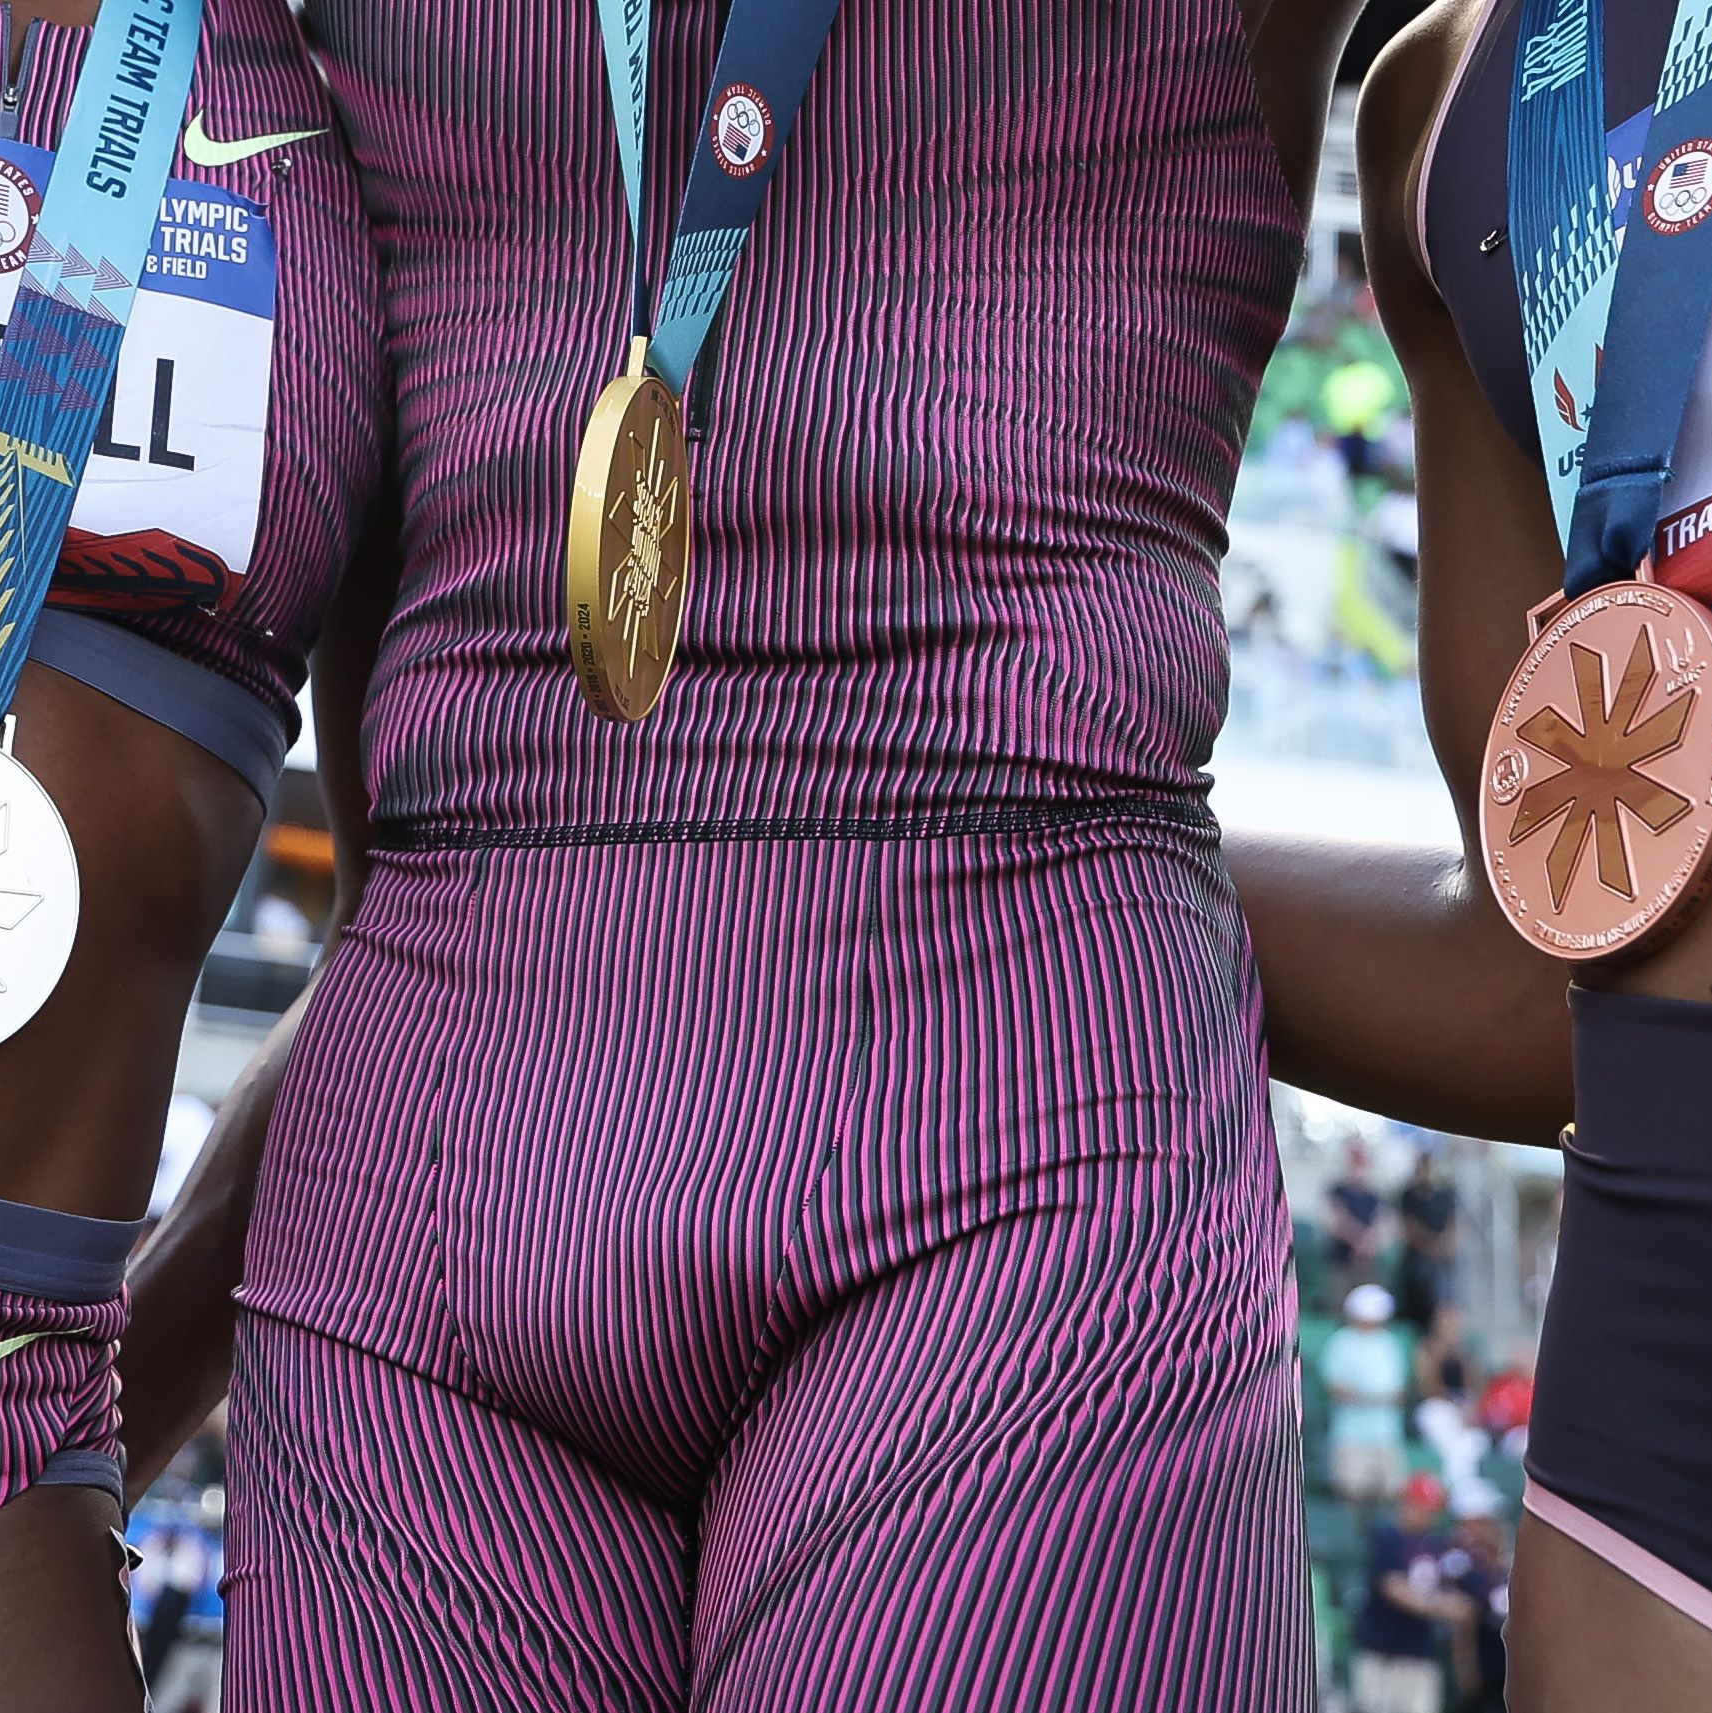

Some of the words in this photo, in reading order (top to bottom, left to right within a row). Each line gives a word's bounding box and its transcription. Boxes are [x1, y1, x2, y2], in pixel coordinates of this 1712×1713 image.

[116, 12, 170, 93] TEAM
[1520, 22, 1560, 103] 2024
[86, 94, 150, 199] TRIALS
[1658, 142, 1694, 170] UNITED
[159, 196, 248, 233] LYMPIC
[160, 226, 247, 264] TRIALS
[145, 254, 158, 273] &
[162, 256, 207, 280] FIELD
[577, 602, 591, 631] 2024
[580, 641, 595, 667] 2020
